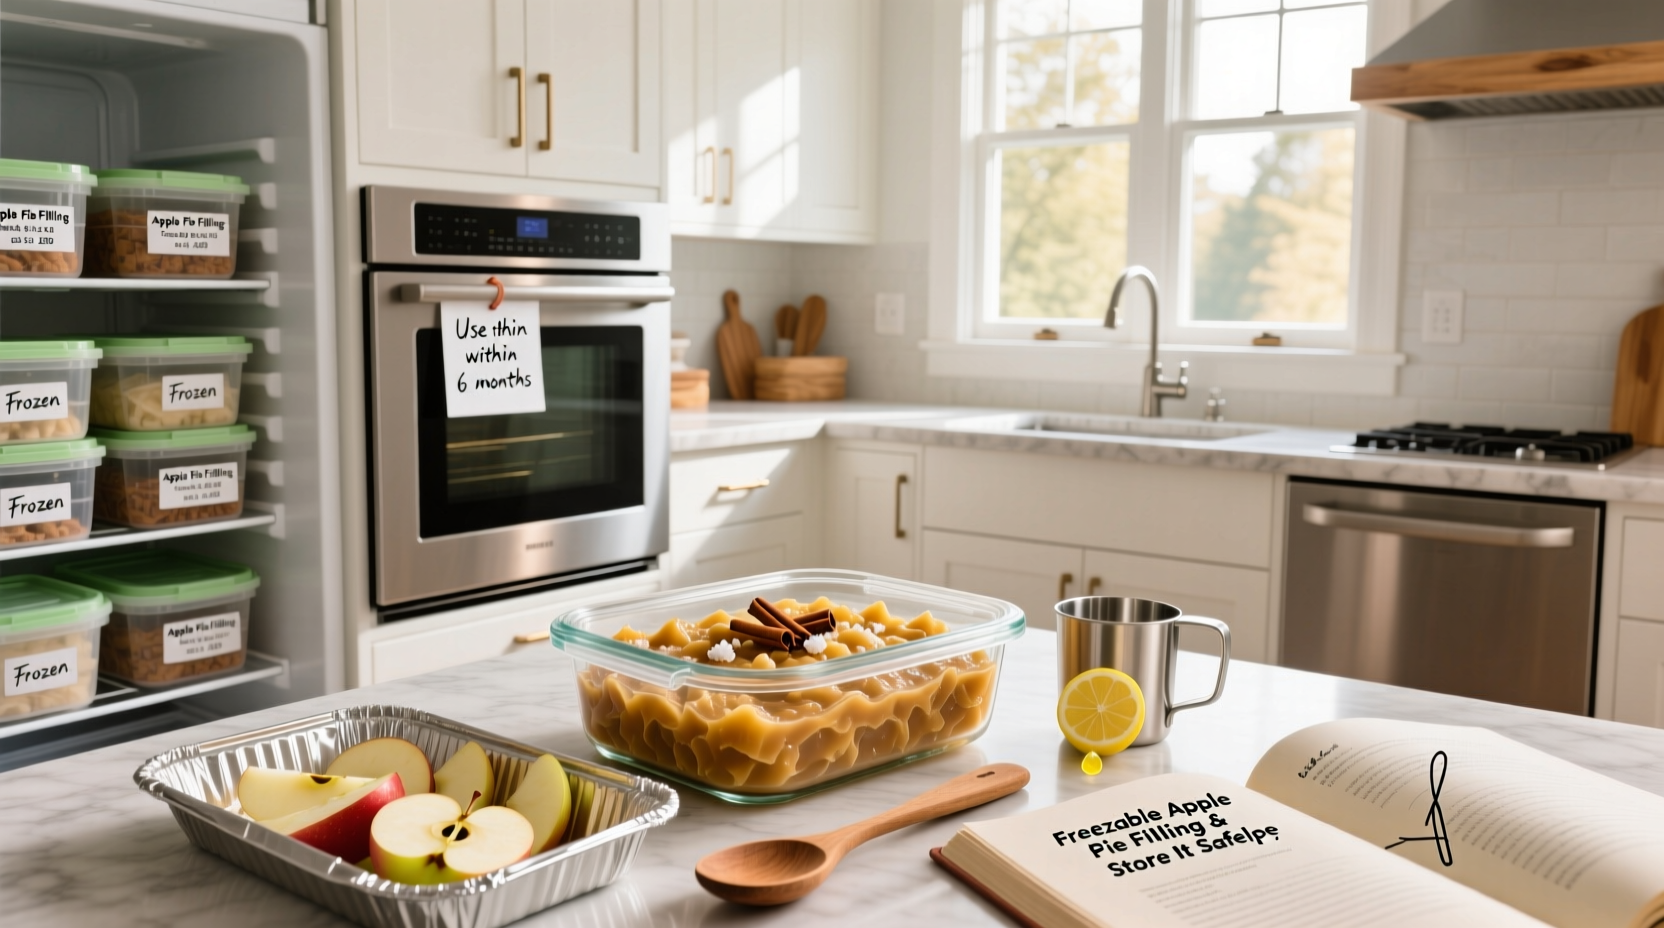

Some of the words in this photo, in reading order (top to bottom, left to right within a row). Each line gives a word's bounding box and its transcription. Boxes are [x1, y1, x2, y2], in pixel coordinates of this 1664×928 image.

[456, 317, 487, 339] Use
[465, 343, 517, 364] within
[170, 382, 217, 403] Frozen
[457, 371, 468, 393] 6
[475, 367, 532, 390] months
[5, 390, 60, 415] Frozen
[8, 494, 64, 519] Frozen
[13, 662, 69, 688] Frozen
[1052, 808, 1163, 847] Freezable
[1167, 792, 1232, 818] Apple
[1088, 839, 1128, 859] Pie
[1128, 820, 1207, 848] Filling
[1208, 813, 1228, 828] &
[1107, 852, 1171, 877] Store
[1171, 843, 1195, 860] It
